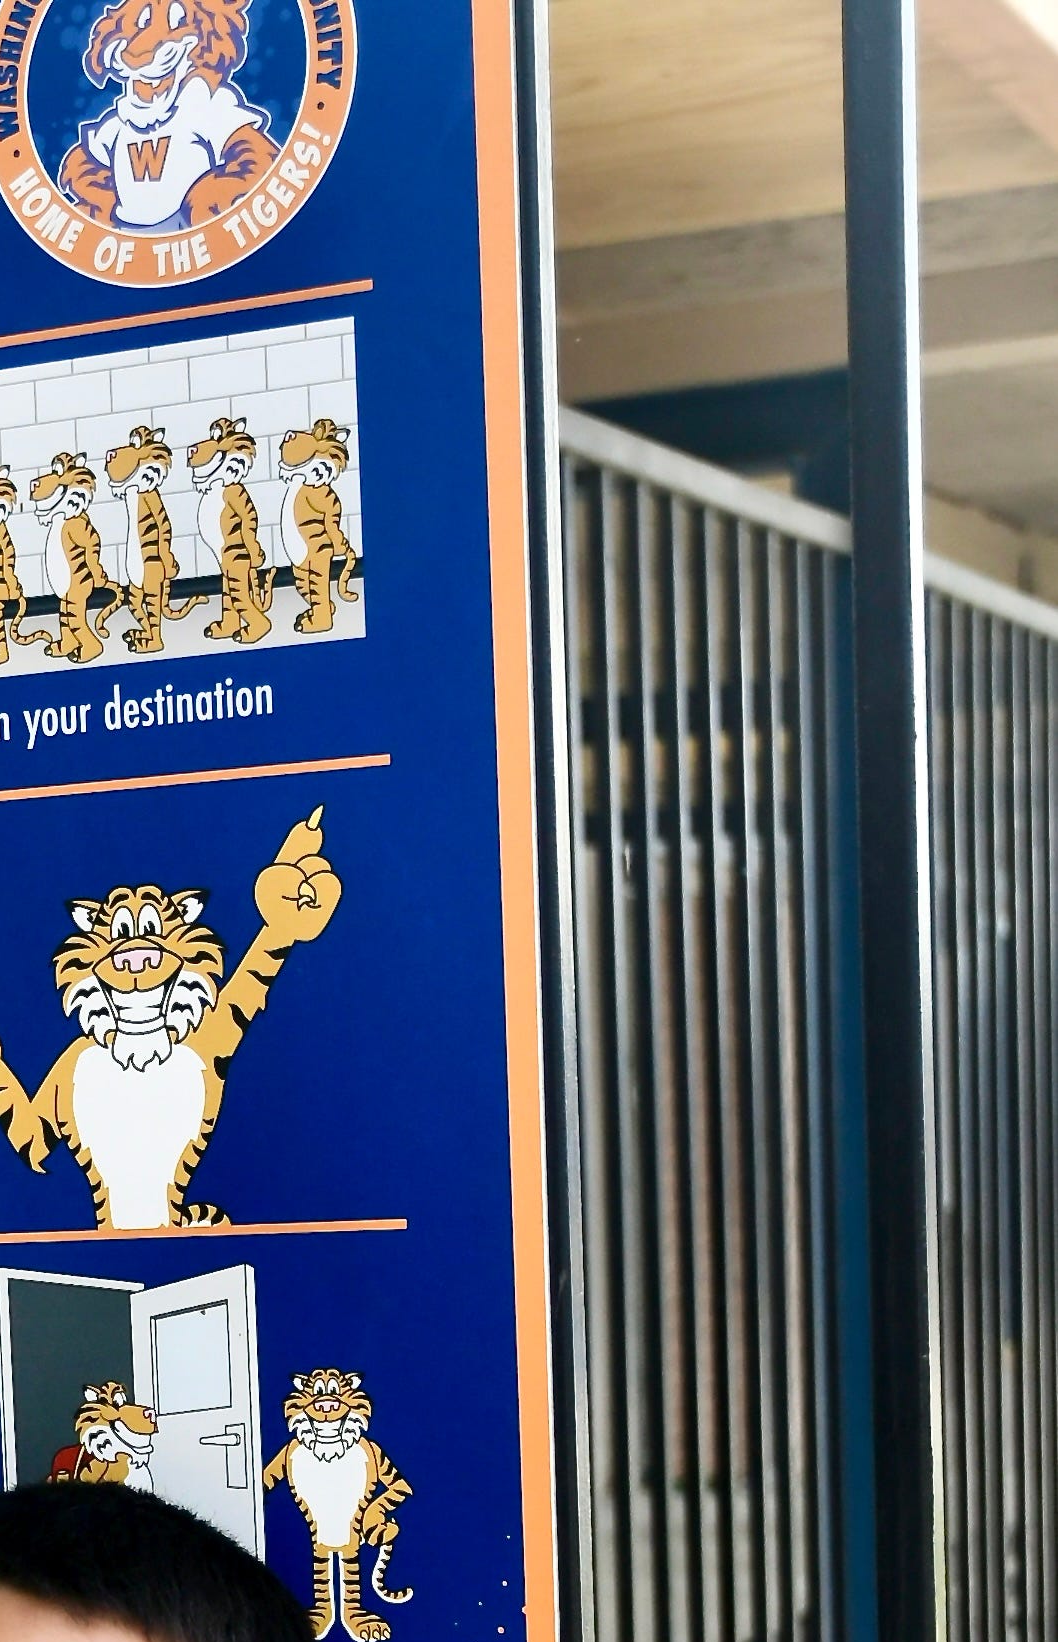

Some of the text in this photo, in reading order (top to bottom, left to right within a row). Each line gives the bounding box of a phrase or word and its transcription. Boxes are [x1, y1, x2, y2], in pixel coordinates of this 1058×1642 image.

[308, 0, 342, 89] NITY
[127, 135, 170, 181] W
[8, 122, 332, 276] HOME OF THE TIGERS!
[22, 703, 92, 750] your
[104, 677, 273, 731] destination
